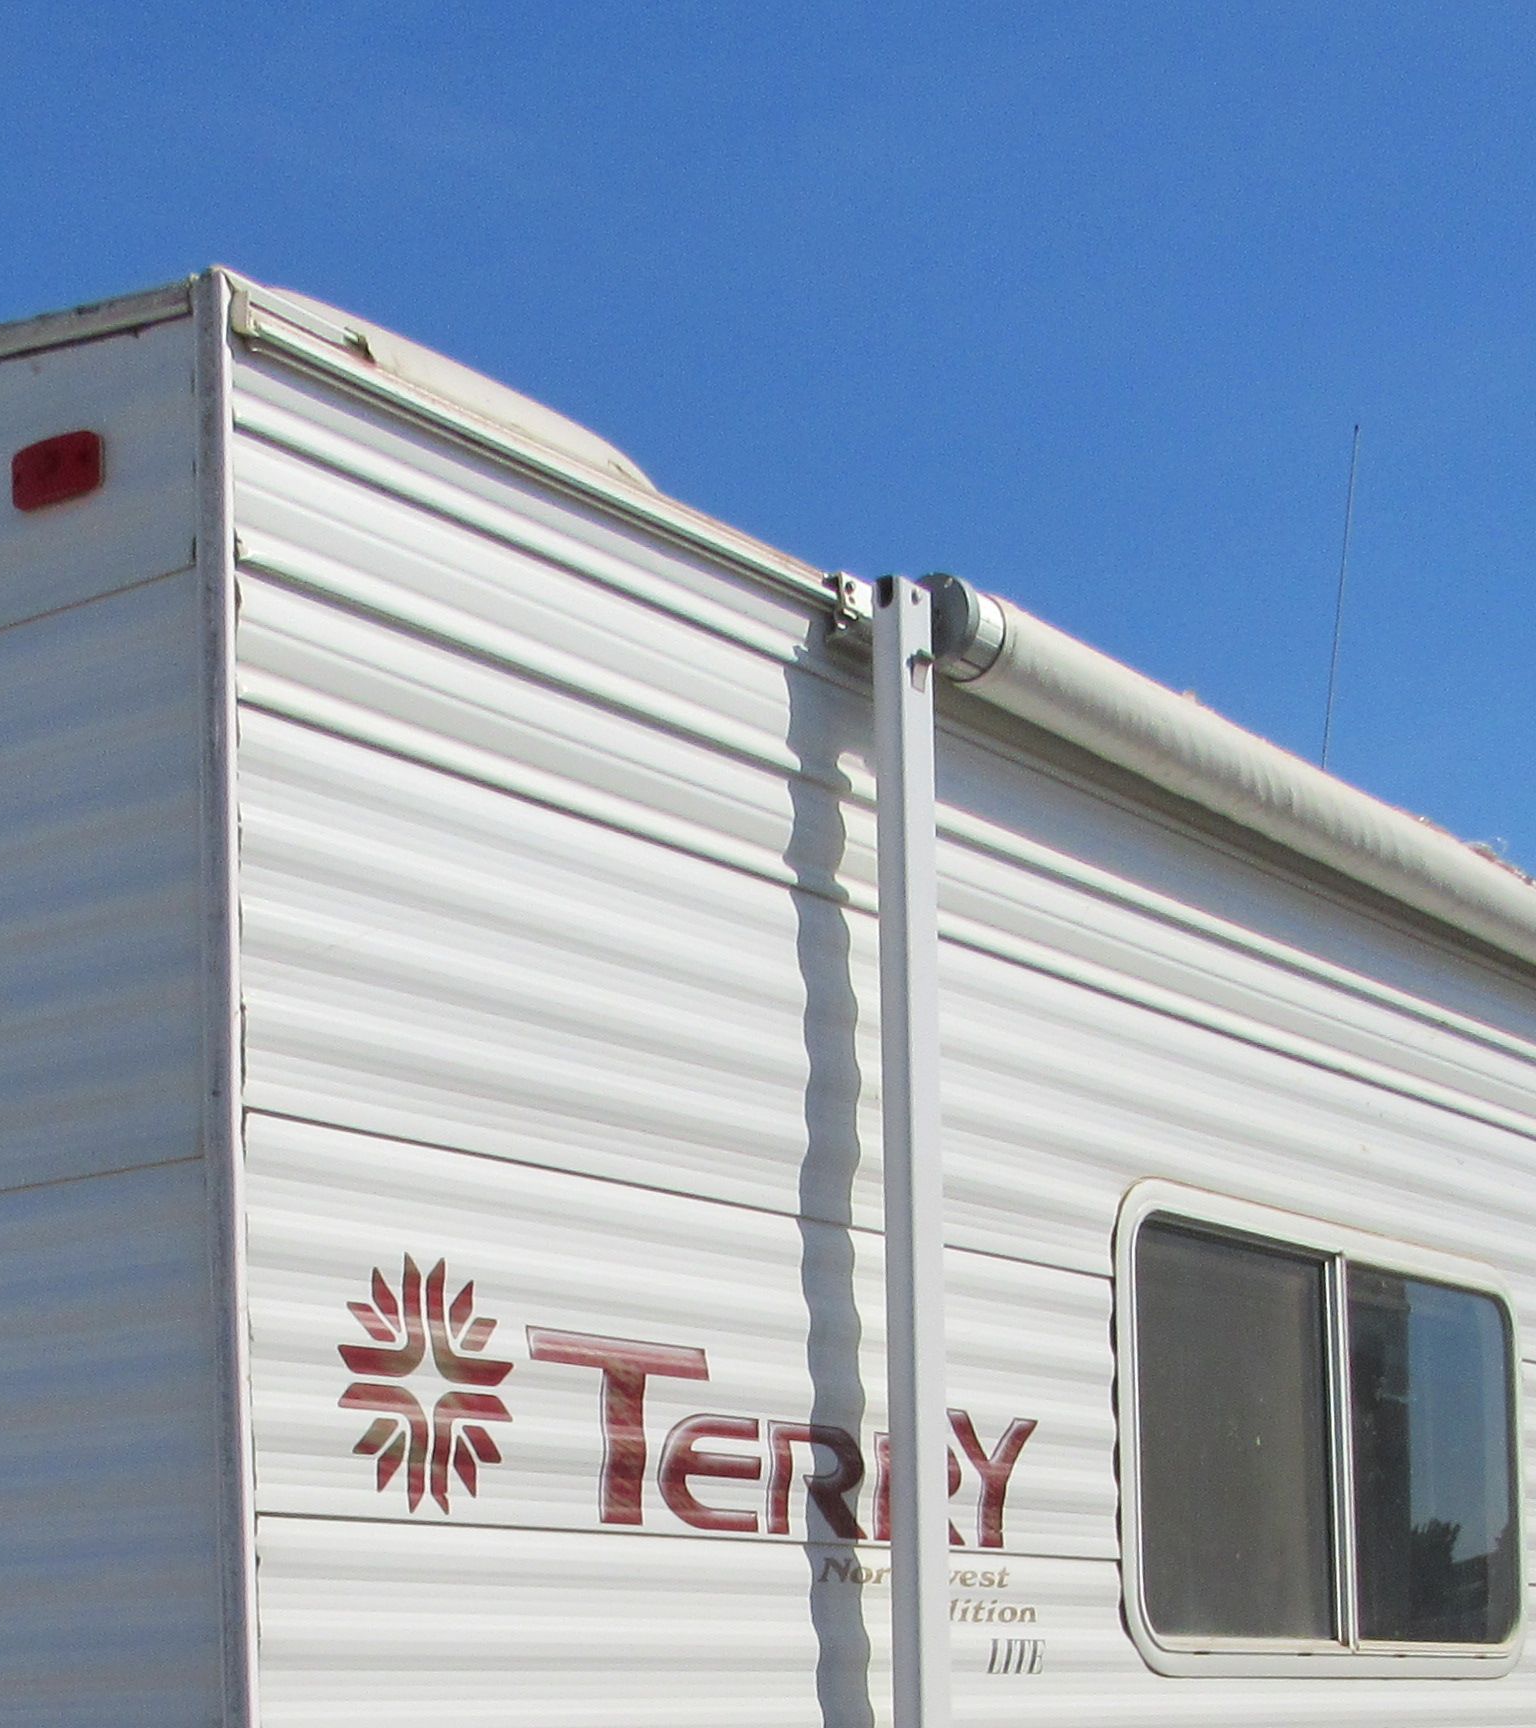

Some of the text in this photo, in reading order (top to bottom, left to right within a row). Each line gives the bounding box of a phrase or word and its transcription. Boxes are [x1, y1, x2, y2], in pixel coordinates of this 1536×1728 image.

[817, 1557, 1010, 1589] Norest
[949, 1598, 1037, 1624] ition
[987, 1638, 1047, 1675] LITE
